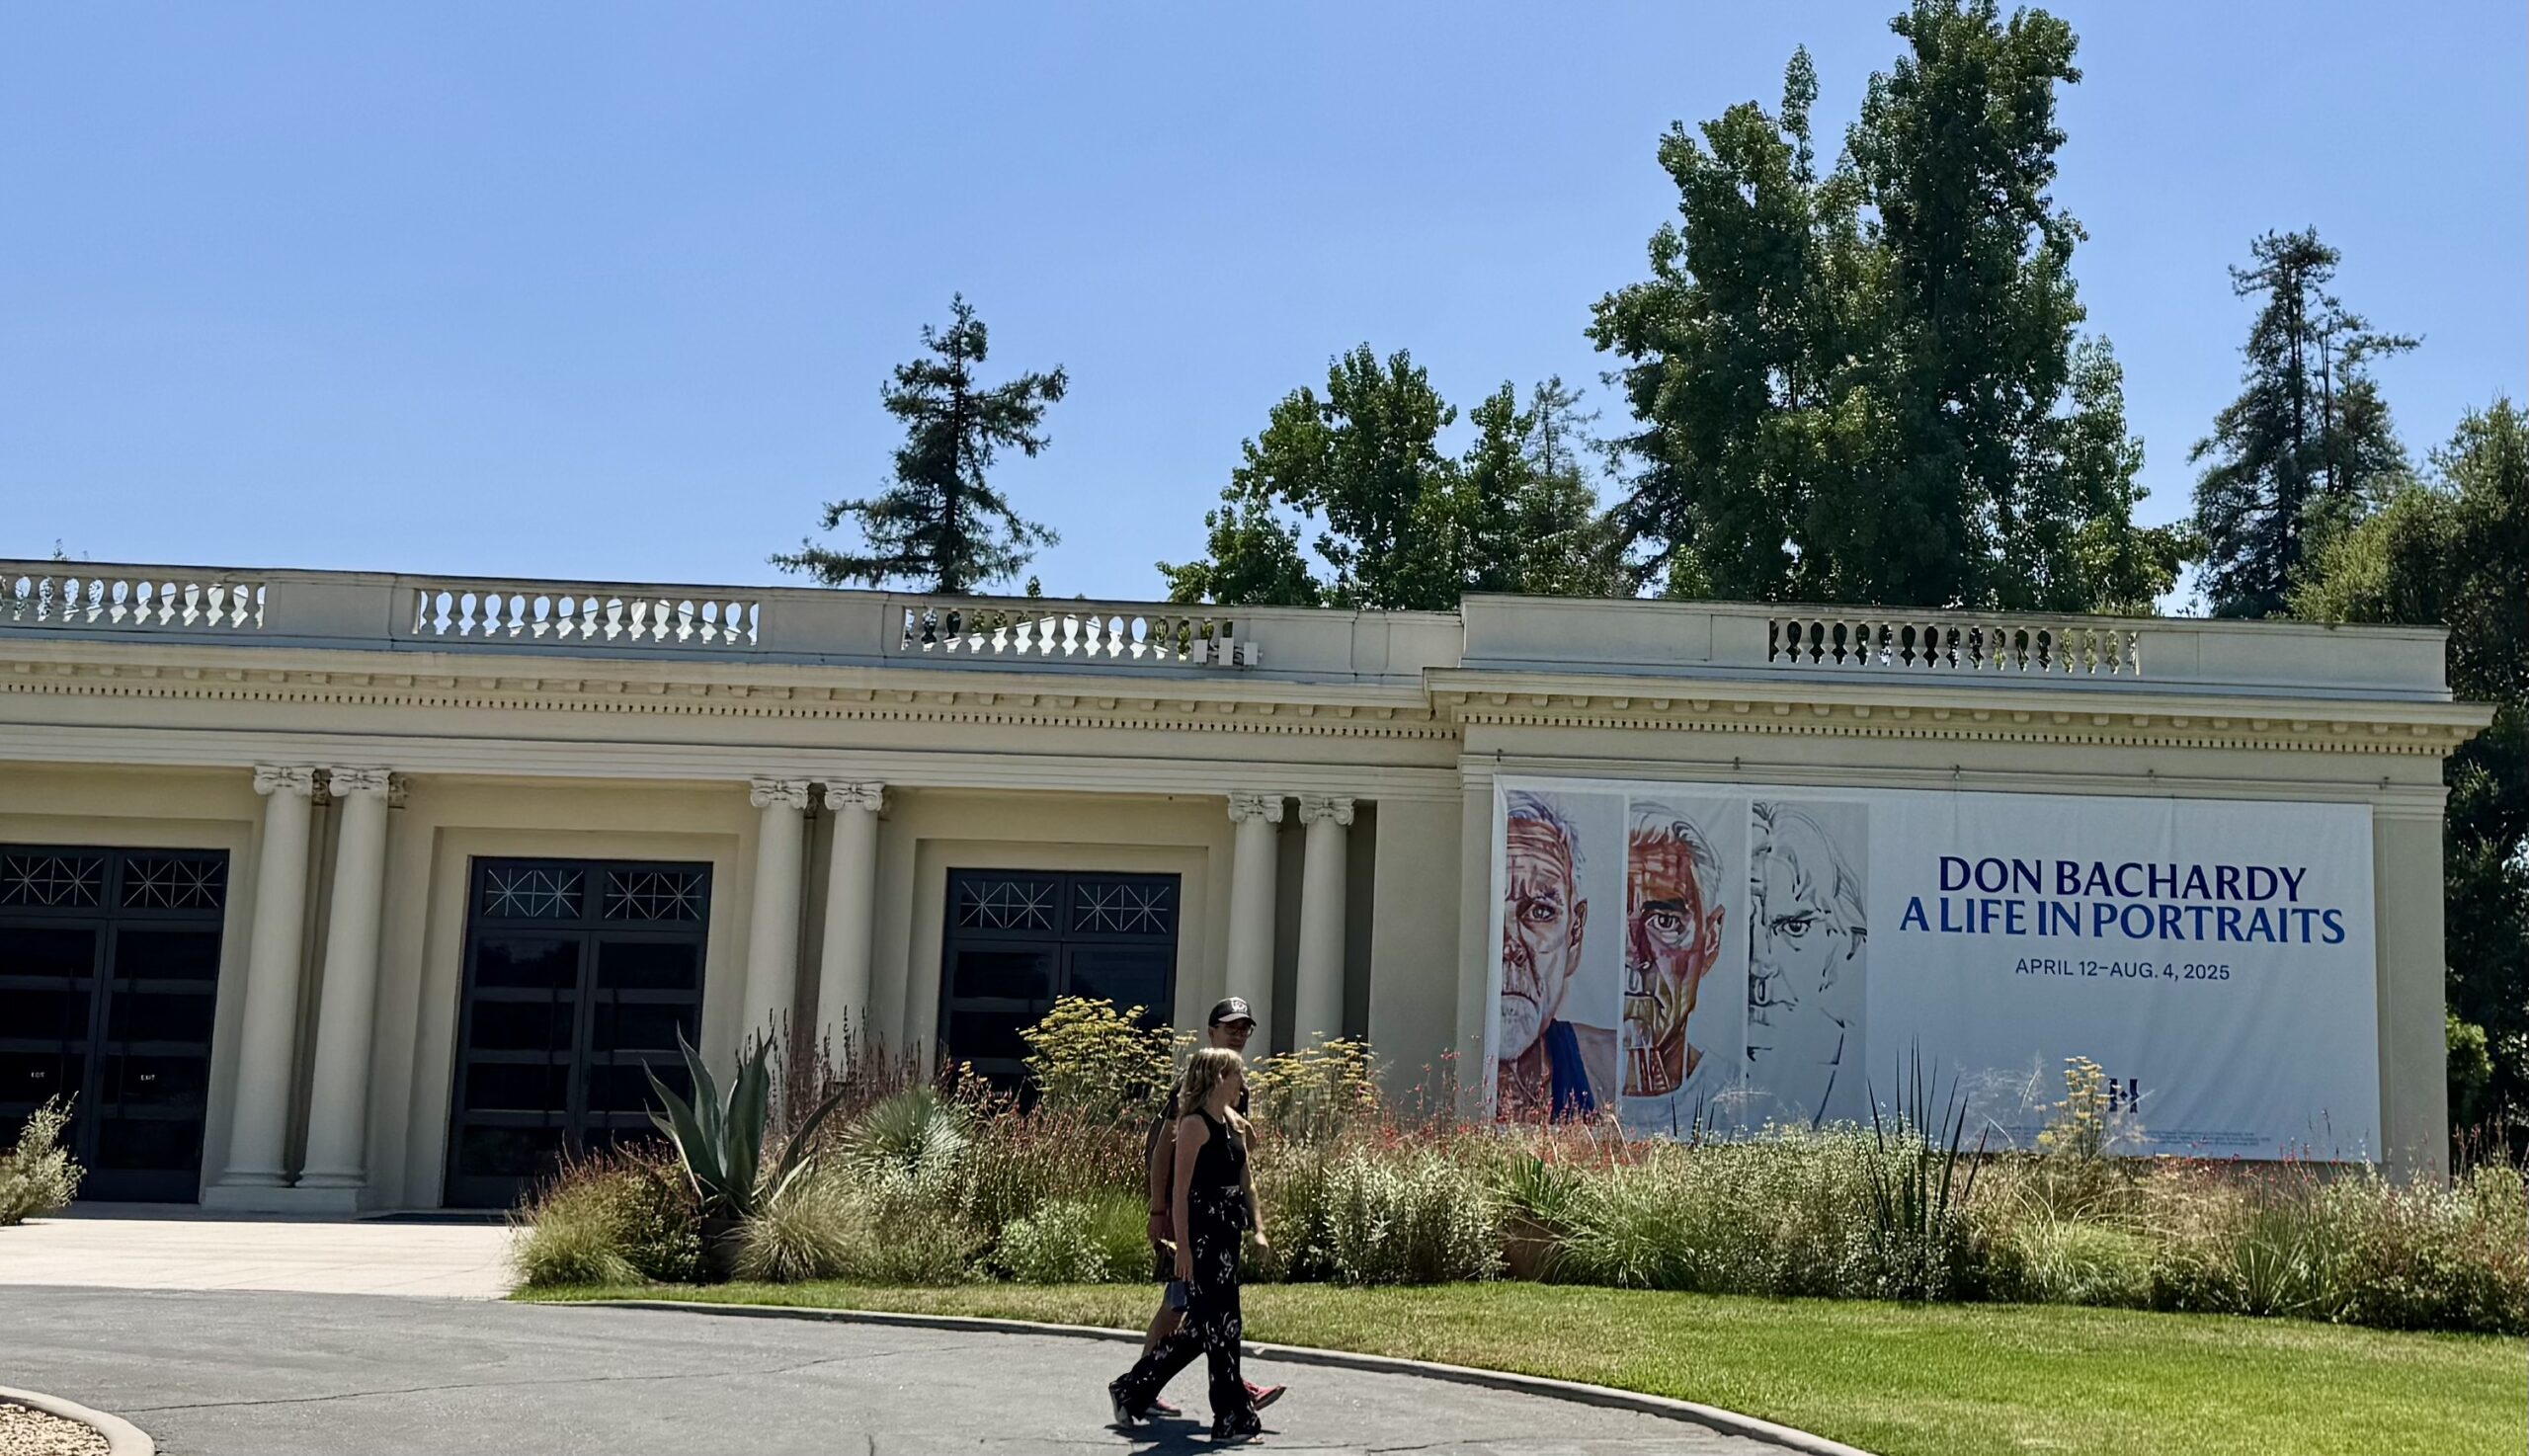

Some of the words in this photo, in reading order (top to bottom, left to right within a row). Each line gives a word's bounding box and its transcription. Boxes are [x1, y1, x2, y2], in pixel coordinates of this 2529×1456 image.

[1939, 856, 2042, 895] DON
[2056, 860, 2307, 902] BACHARDY
[1899, 896, 1930, 932] A
[1939, 897, 2026, 935] LIFE
[2038, 901, 2080, 936] IN
[2092, 903, 2345, 944] PORTRAITS
[2015, 957, 2074, 976] APRIL
[2162, 962, 2179, 983] 4,
[2183, 963, 2230, 981] 2025
